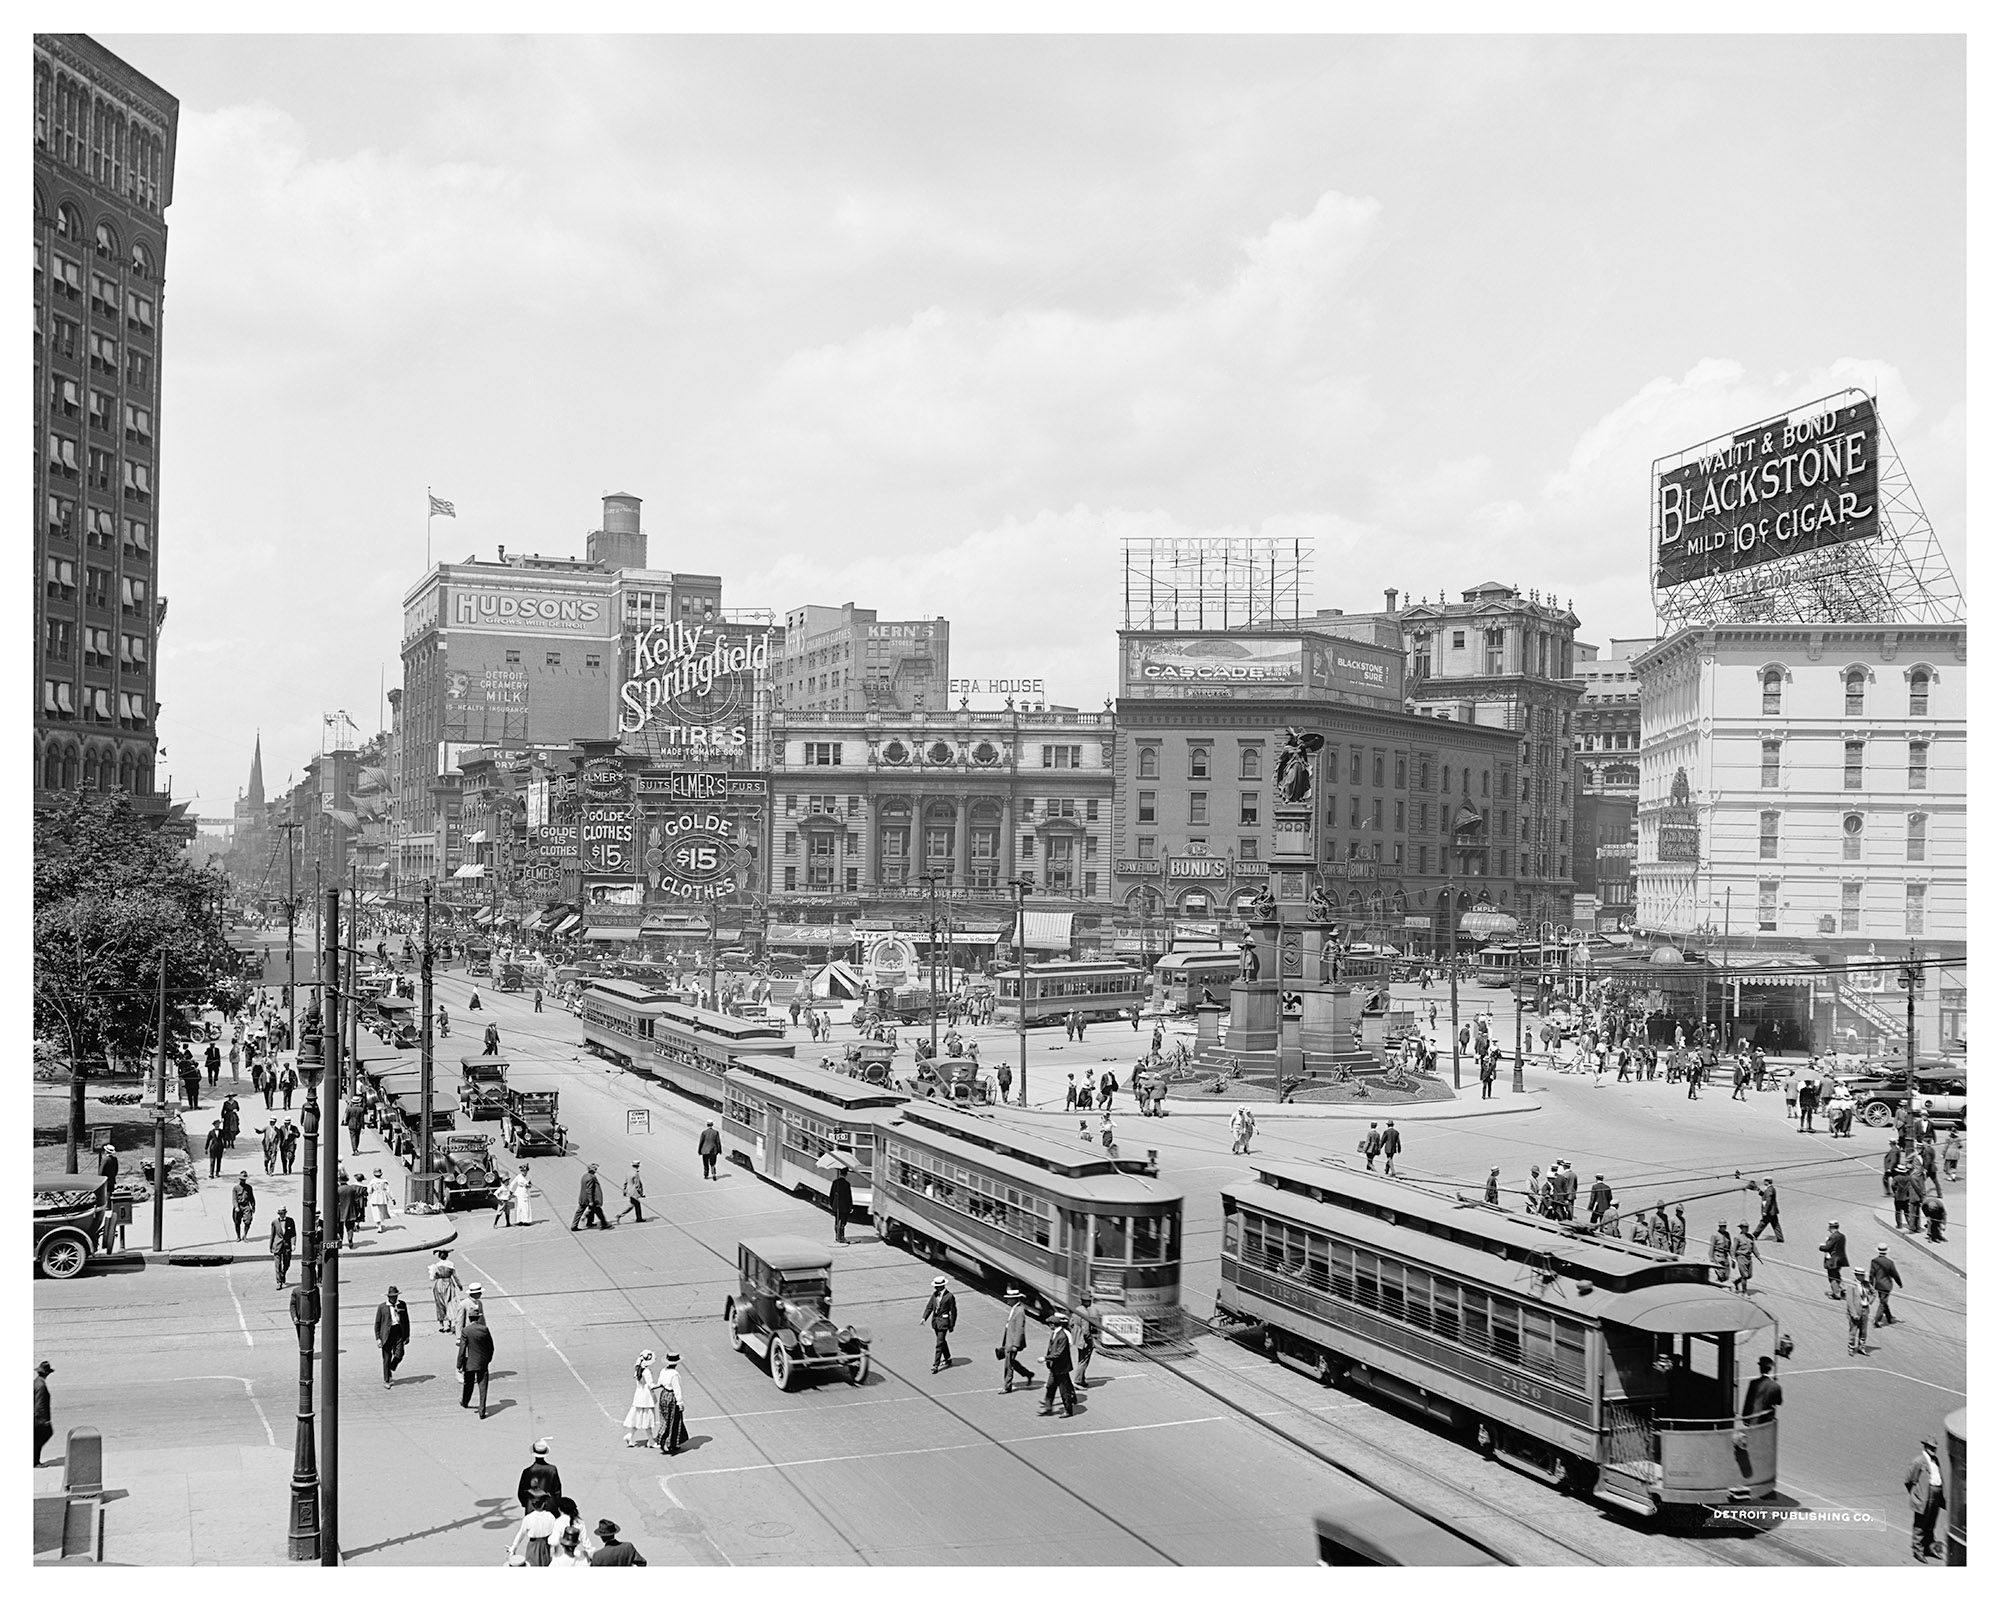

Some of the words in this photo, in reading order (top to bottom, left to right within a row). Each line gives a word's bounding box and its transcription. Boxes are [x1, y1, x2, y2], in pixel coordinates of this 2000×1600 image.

[1698, 438, 1756, 477] WAITT
[1761, 432, 1773, 455] &
[1783, 410, 1837, 450] BOND
[1660, 430, 1867, 545] BLACKSTONE
[1687, 530, 1726, 556] MILD
[1732, 518, 1770, 553] 10¢
[1776, 492, 1873, 541] CIGAR
[1174, 568, 1266, 590] FLOUR
[1725, 582, 1744, 597] LEE
[1756, 573, 1788, 589] CADY
[456, 594, 600, 623] HUDSON'S
[868, 625, 934, 637] KERN'S
[1144, 666, 1265, 677] CASCADE
[1337, 658, 1383, 674] BLACKSTONE
[486, 671, 524, 680] DETROIT
[1364, 671, 1383, 682] SURE
[480, 680, 528, 690] CREAMERY
[618, 634, 769, 734] Springfield
[989, 679, 1043, 693] HOUSE
[486, 691, 521, 703] MILK
[489, 706, 529, 714] INSURANCE
[667, 726, 746, 746] TIRES
[494, 750, 548, 761] KES
[660, 747, 683, 756] MADE
[685, 747, 695, 756] TO
[698, 747, 721, 756] MAKE
[723, 747, 745, 757] GOOD
[583, 772, 624, 783] ELMER'S
[639, 781, 671, 790] SUITS
[673, 773, 726, 799] ELMER'S
[732, 782, 760, 791] FURS
[589, 811, 625, 822] GOLDE
[540, 826, 577, 838] GOLDE
[583, 825, 632, 842] CLOTHES
[664, 815, 733, 838] GOLDE
[540, 845, 578, 856] CLOTHES
[591, 844, 622, 866] $15
[676, 847, 717, 870] $15
[1171, 860, 1225, 877] BOND'S
[1237, 863, 1270, 874] CLOTHE
[1350, 863, 1376, 878] BOND'S
[661, 876, 736, 900] CLOTHES
[1469, 905, 1497, 913] TEMPLE
[323, 1241, 338, 1249] FORT
[1501, 1375, 1542, 1400] 7126
